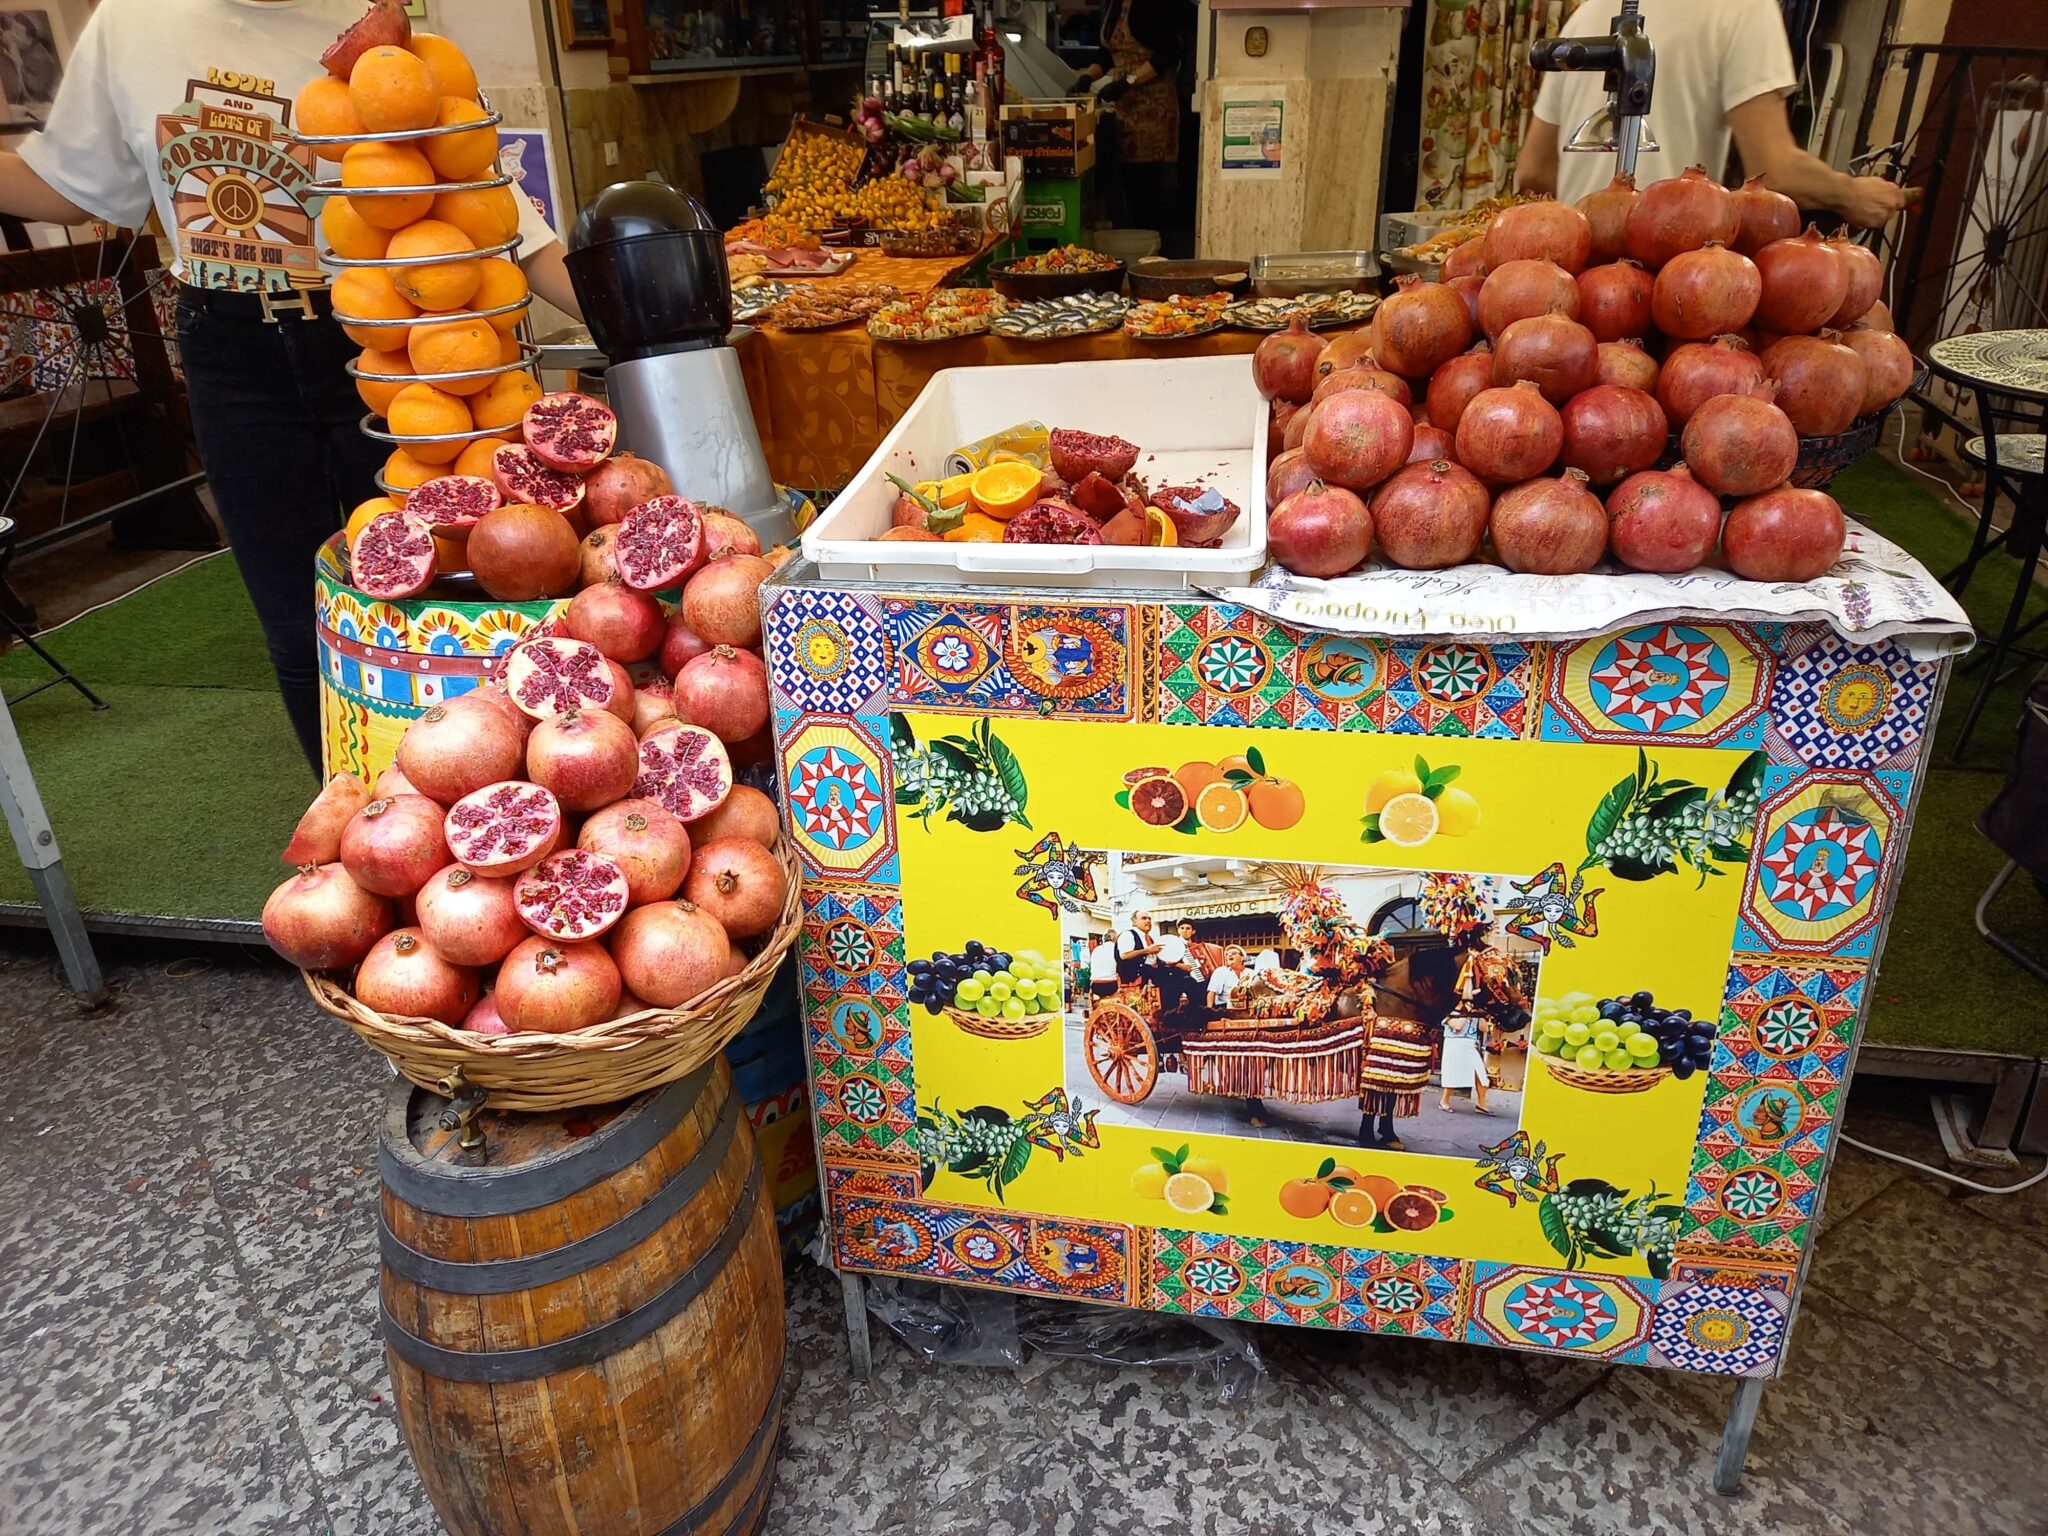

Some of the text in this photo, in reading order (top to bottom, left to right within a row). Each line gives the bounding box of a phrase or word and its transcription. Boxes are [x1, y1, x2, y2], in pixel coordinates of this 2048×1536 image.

[207, 66, 275, 96] LOVE
[223, 98, 253, 111] AND
[209, 112, 264, 136] LOTS OF
[1024, 207, 1061, 219] FORST
[190, 237, 230, 259] THAT'S
[1449, 612, 1516, 632] Olea
[1186, 903, 1241, 916] GALEANO
